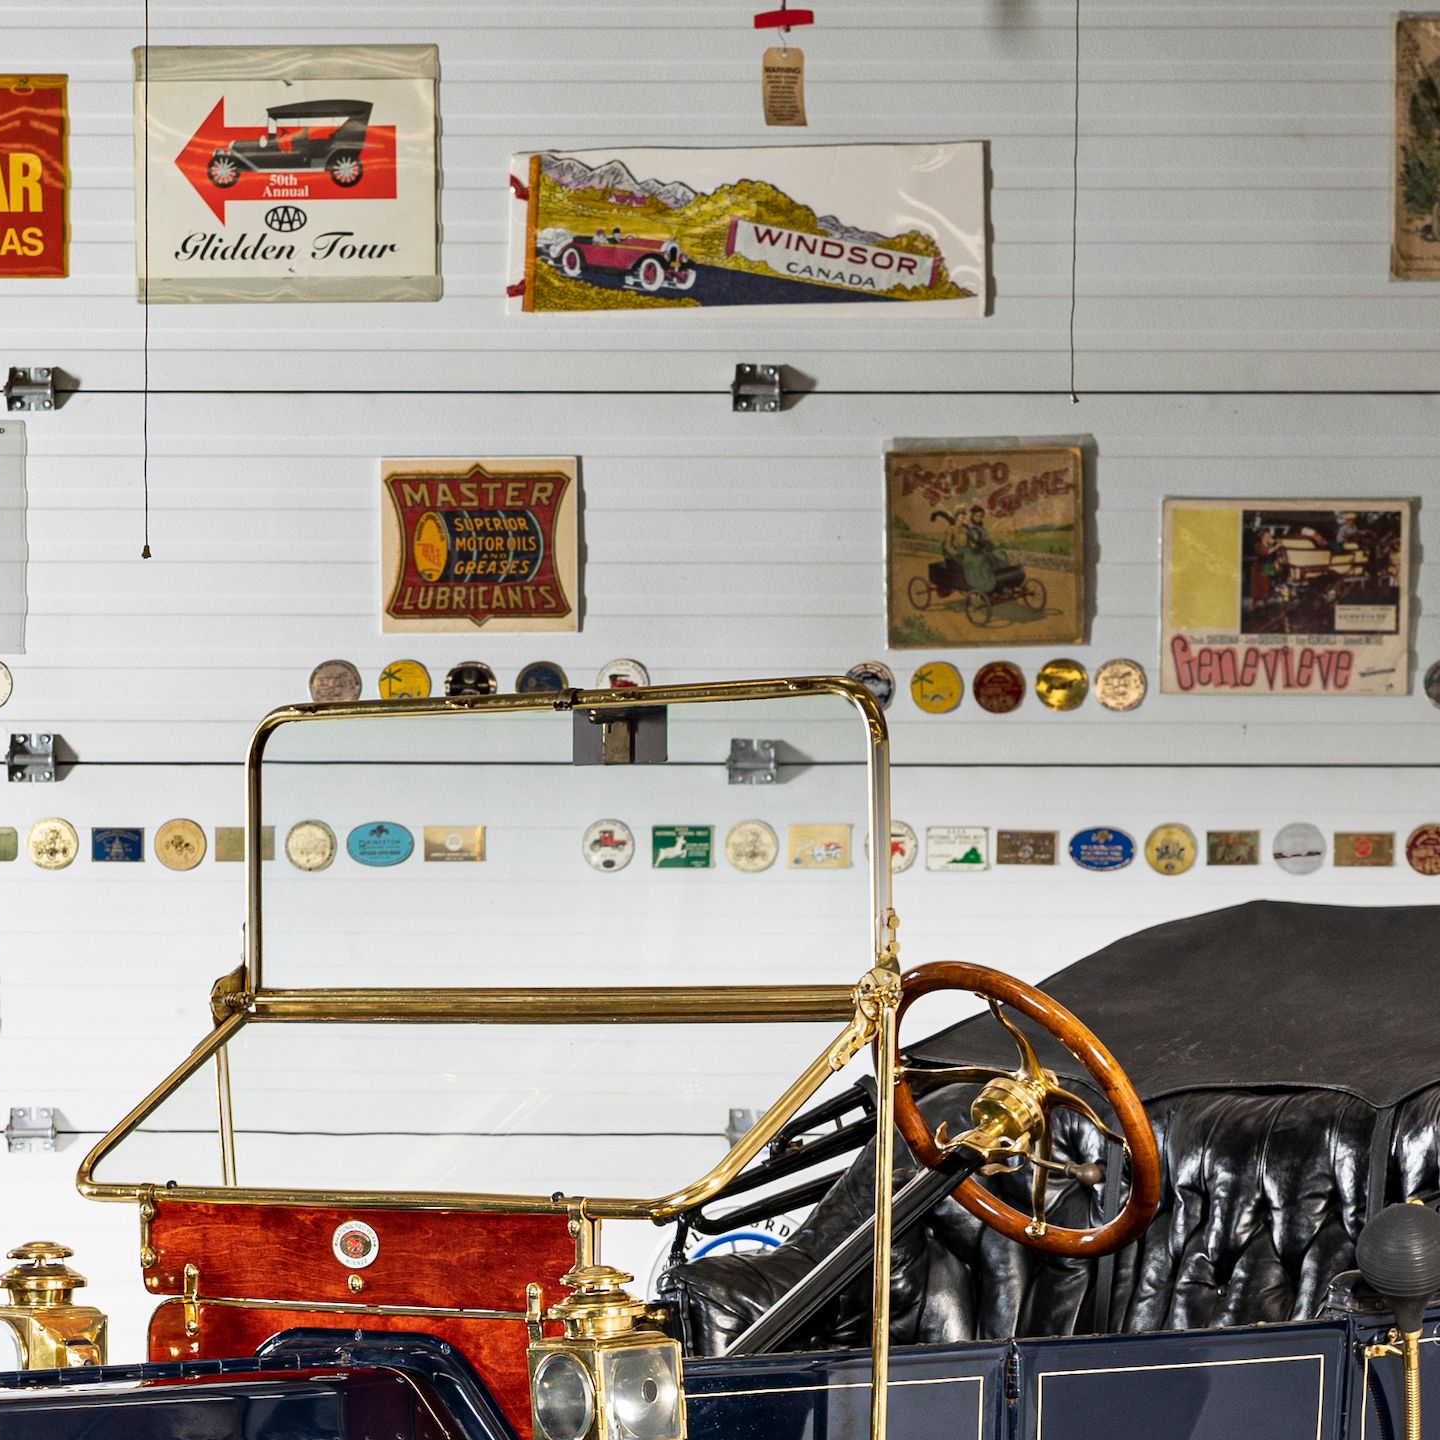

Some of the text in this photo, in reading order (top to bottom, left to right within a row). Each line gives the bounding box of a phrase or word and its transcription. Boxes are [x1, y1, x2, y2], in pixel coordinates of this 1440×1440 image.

[262, 185, 310, 198] Annual
[269, 173, 298, 187] 50th
[270, 206, 302, 231] AAA
[174, 230, 399, 261] Glidden Tour
[752, 225, 919, 276] WINDSOR
[785, 260, 877, 289] CANADA
[400, 481, 556, 508] MASTER
[986, 467, 1070, 519] GAME
[453, 516, 529, 532] SUPERIOR
[454, 535, 537, 552] MOTOR OILS
[453, 559, 531, 576] GREASES
[402, 585, 557, 611] LUBRICANTS
[1170, 633, 1355, 692] Genevieve
